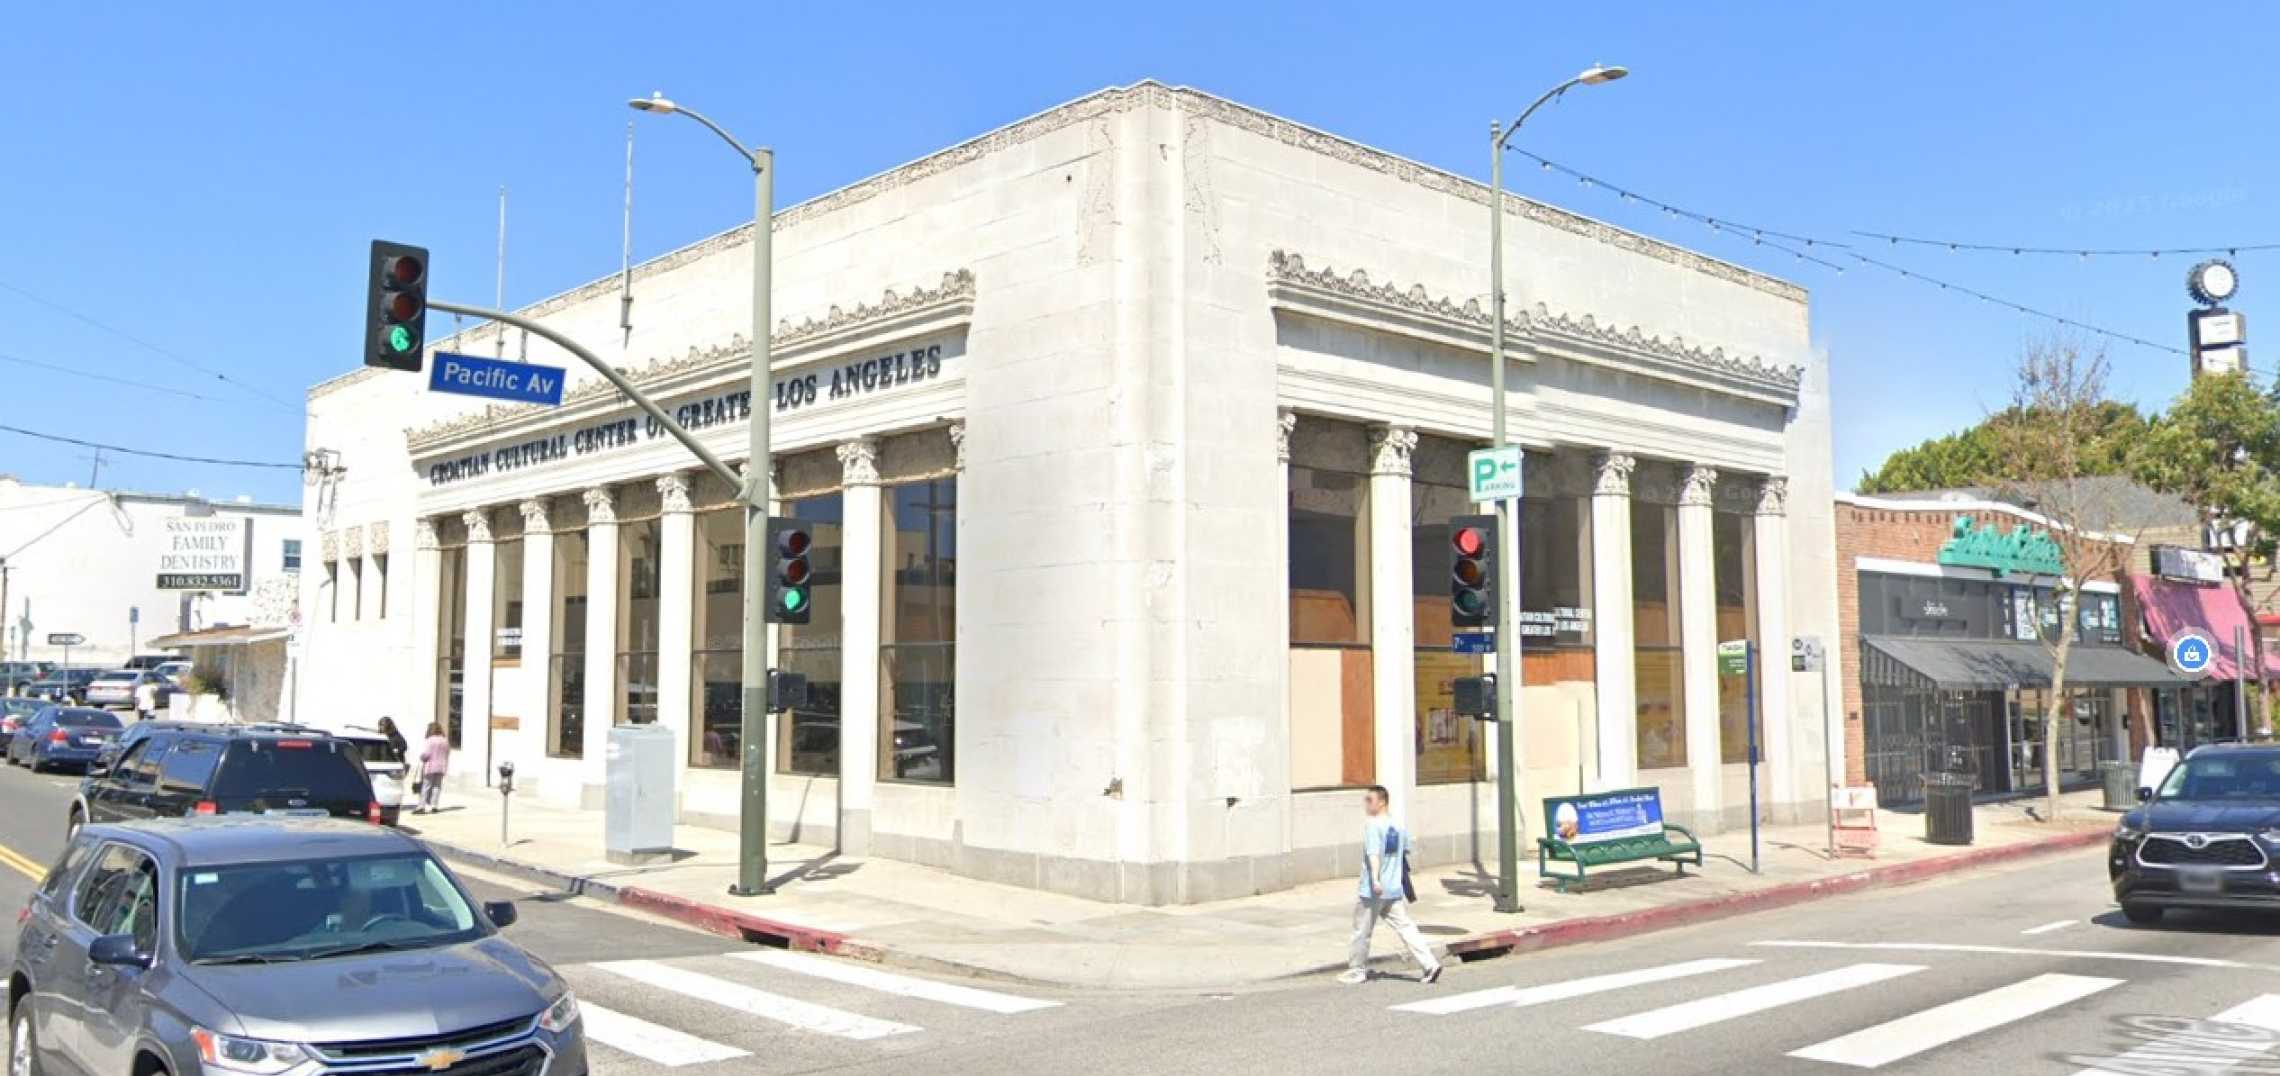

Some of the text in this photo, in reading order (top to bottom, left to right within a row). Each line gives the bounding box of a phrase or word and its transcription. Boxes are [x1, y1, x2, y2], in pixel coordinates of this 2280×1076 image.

[443, 361, 555, 395] Pacific Av
[430, 452, 490, 487] CROATIAN
[496, 433, 568, 473] CULTURAL
[574, 417, 637, 453] CENTER
[677, 389, 751, 430] GREATE
[775, 374, 817, 410] LOS
[828, 344, 941, 398] ANGELES
[167, 520, 236, 532] SAN PEDRO
[172, 535, 225, 551] FAMILY
[160, 553, 237, 570] DENTISTRY
